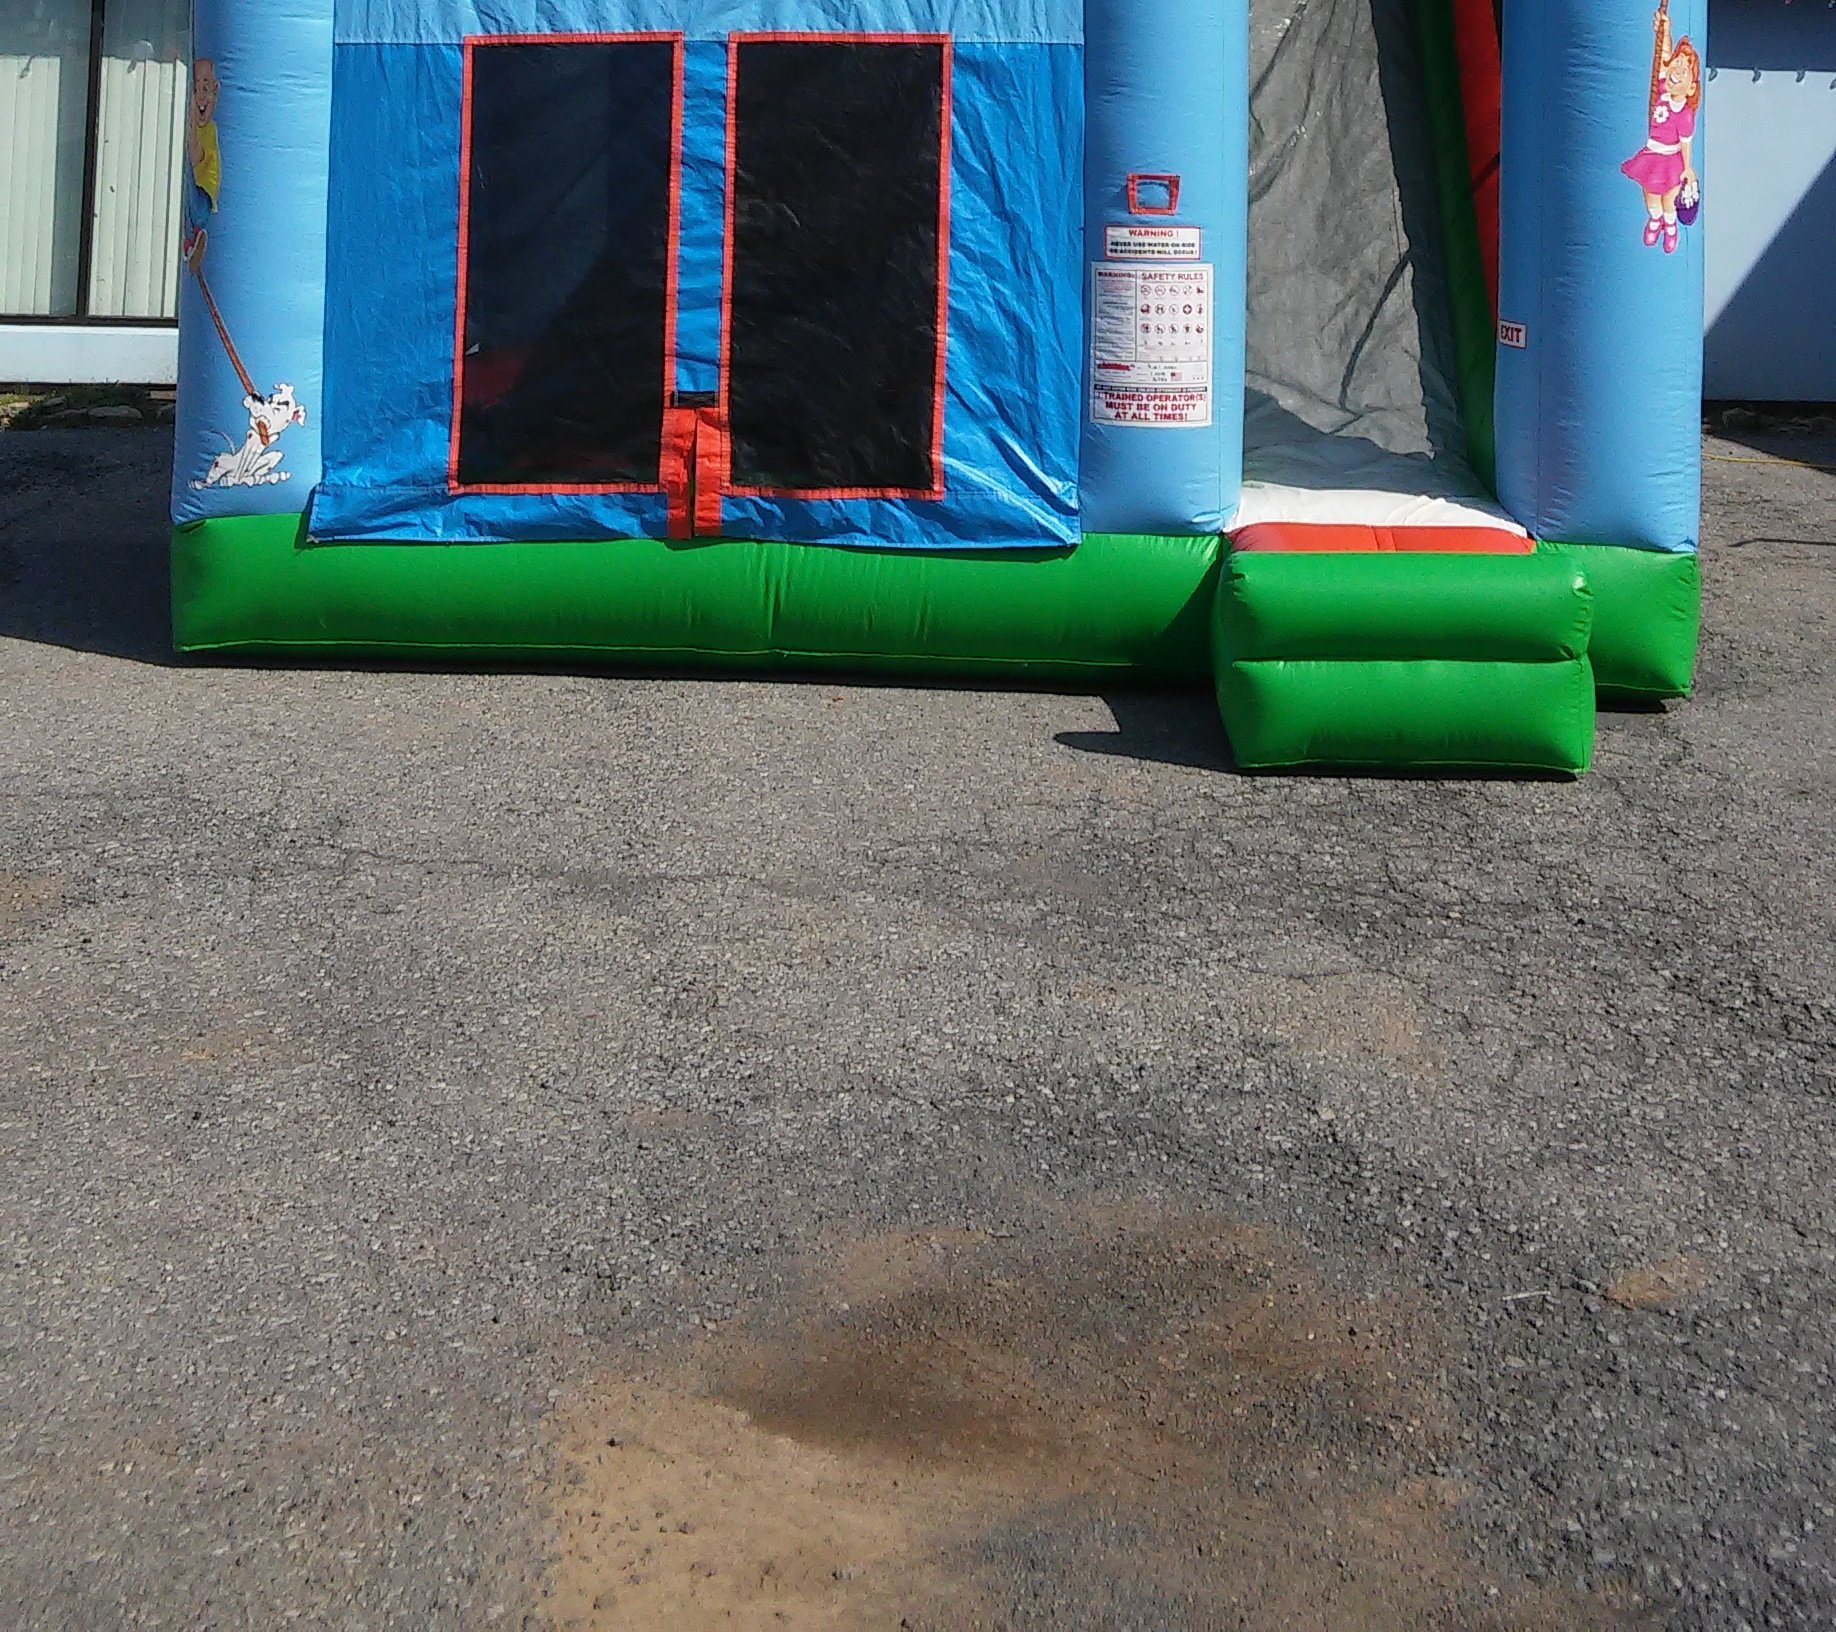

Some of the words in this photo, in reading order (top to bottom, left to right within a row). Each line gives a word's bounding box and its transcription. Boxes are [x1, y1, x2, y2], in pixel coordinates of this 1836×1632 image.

[1129, 229, 1173, 237] WARNING
[1142, 273, 1176, 281] SAFETY
[1178, 273, 1204, 281] RULES
[1501, 324, 1522, 343] EXIT
[1104, 392, 1144, 401] TRAINED
[1106, 401, 1133, 410] MUST
[1137, 403, 1150, 411] BE
[1171, 404, 1197, 412] DUTY
[1115, 411, 1129, 420] AT
[1132, 413, 1150, 421] ALL
[1153, 413, 1188, 421] TIMES!
